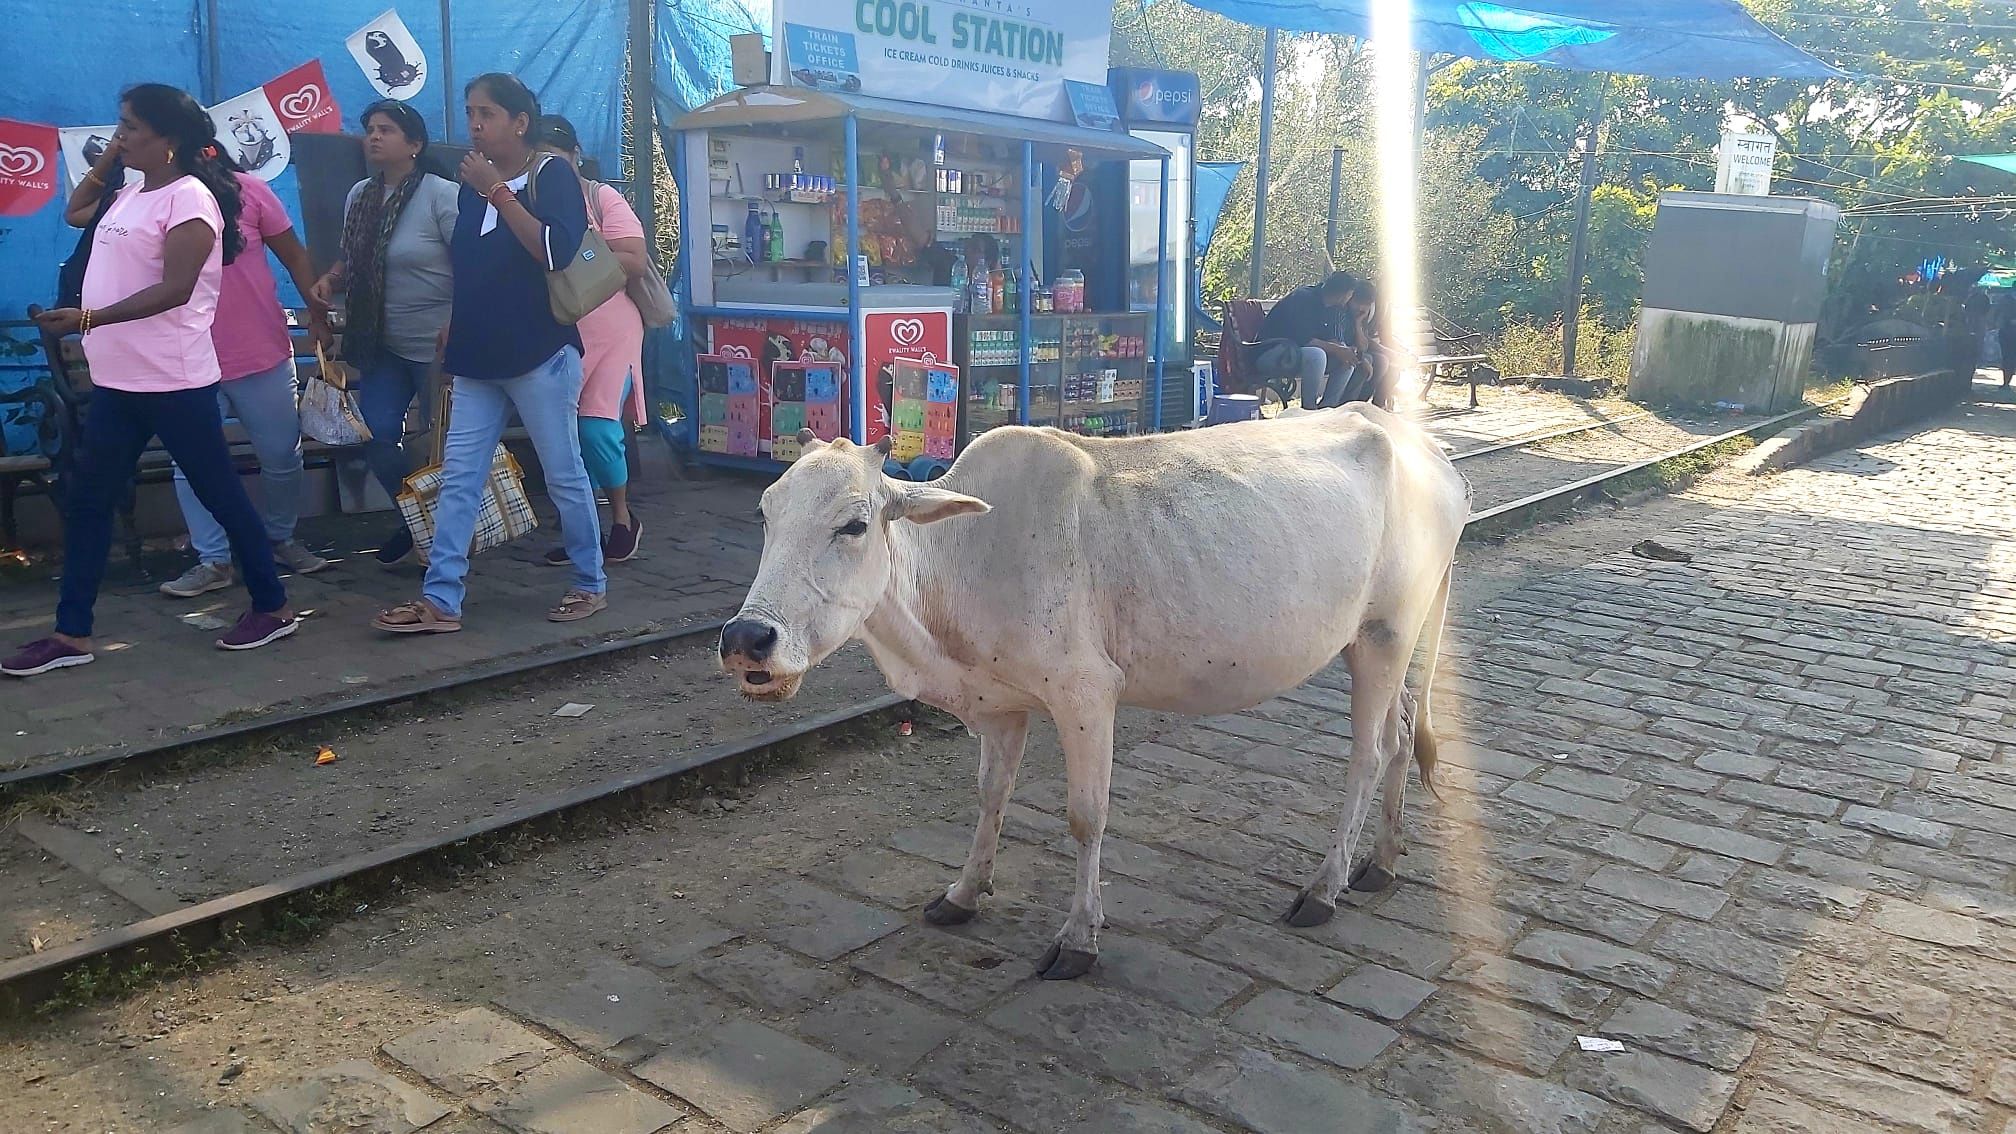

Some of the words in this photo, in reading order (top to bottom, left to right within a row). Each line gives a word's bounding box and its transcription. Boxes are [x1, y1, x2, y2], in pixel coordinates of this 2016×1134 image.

[959, 0, 1031, 17] ANTA'S
[807, 30, 839, 44] TRAIN
[855, 0, 937, 45] COOL
[952, 12, 1064, 67] STATION
[802, 41, 845, 56] TICKETS
[807, 54, 845, 68] OFFICE
[884, 47, 898, 59] ICE
[899, 50, 927, 64] CREAM
[928, 55, 950, 67] COLD
[951, 58, 980, 72] DRINKS
[980, 62, 1005, 76] JUICES
[1006, 66, 1012, 77] &
[1012, 67, 1040, 82] SNACKS
[1155, 88, 1192, 105] pepsi
[311, 105, 333, 120] WALL'S
[1734, 154, 1771, 167] WELCOME
[17, 180, 49, 189] WALL'S
